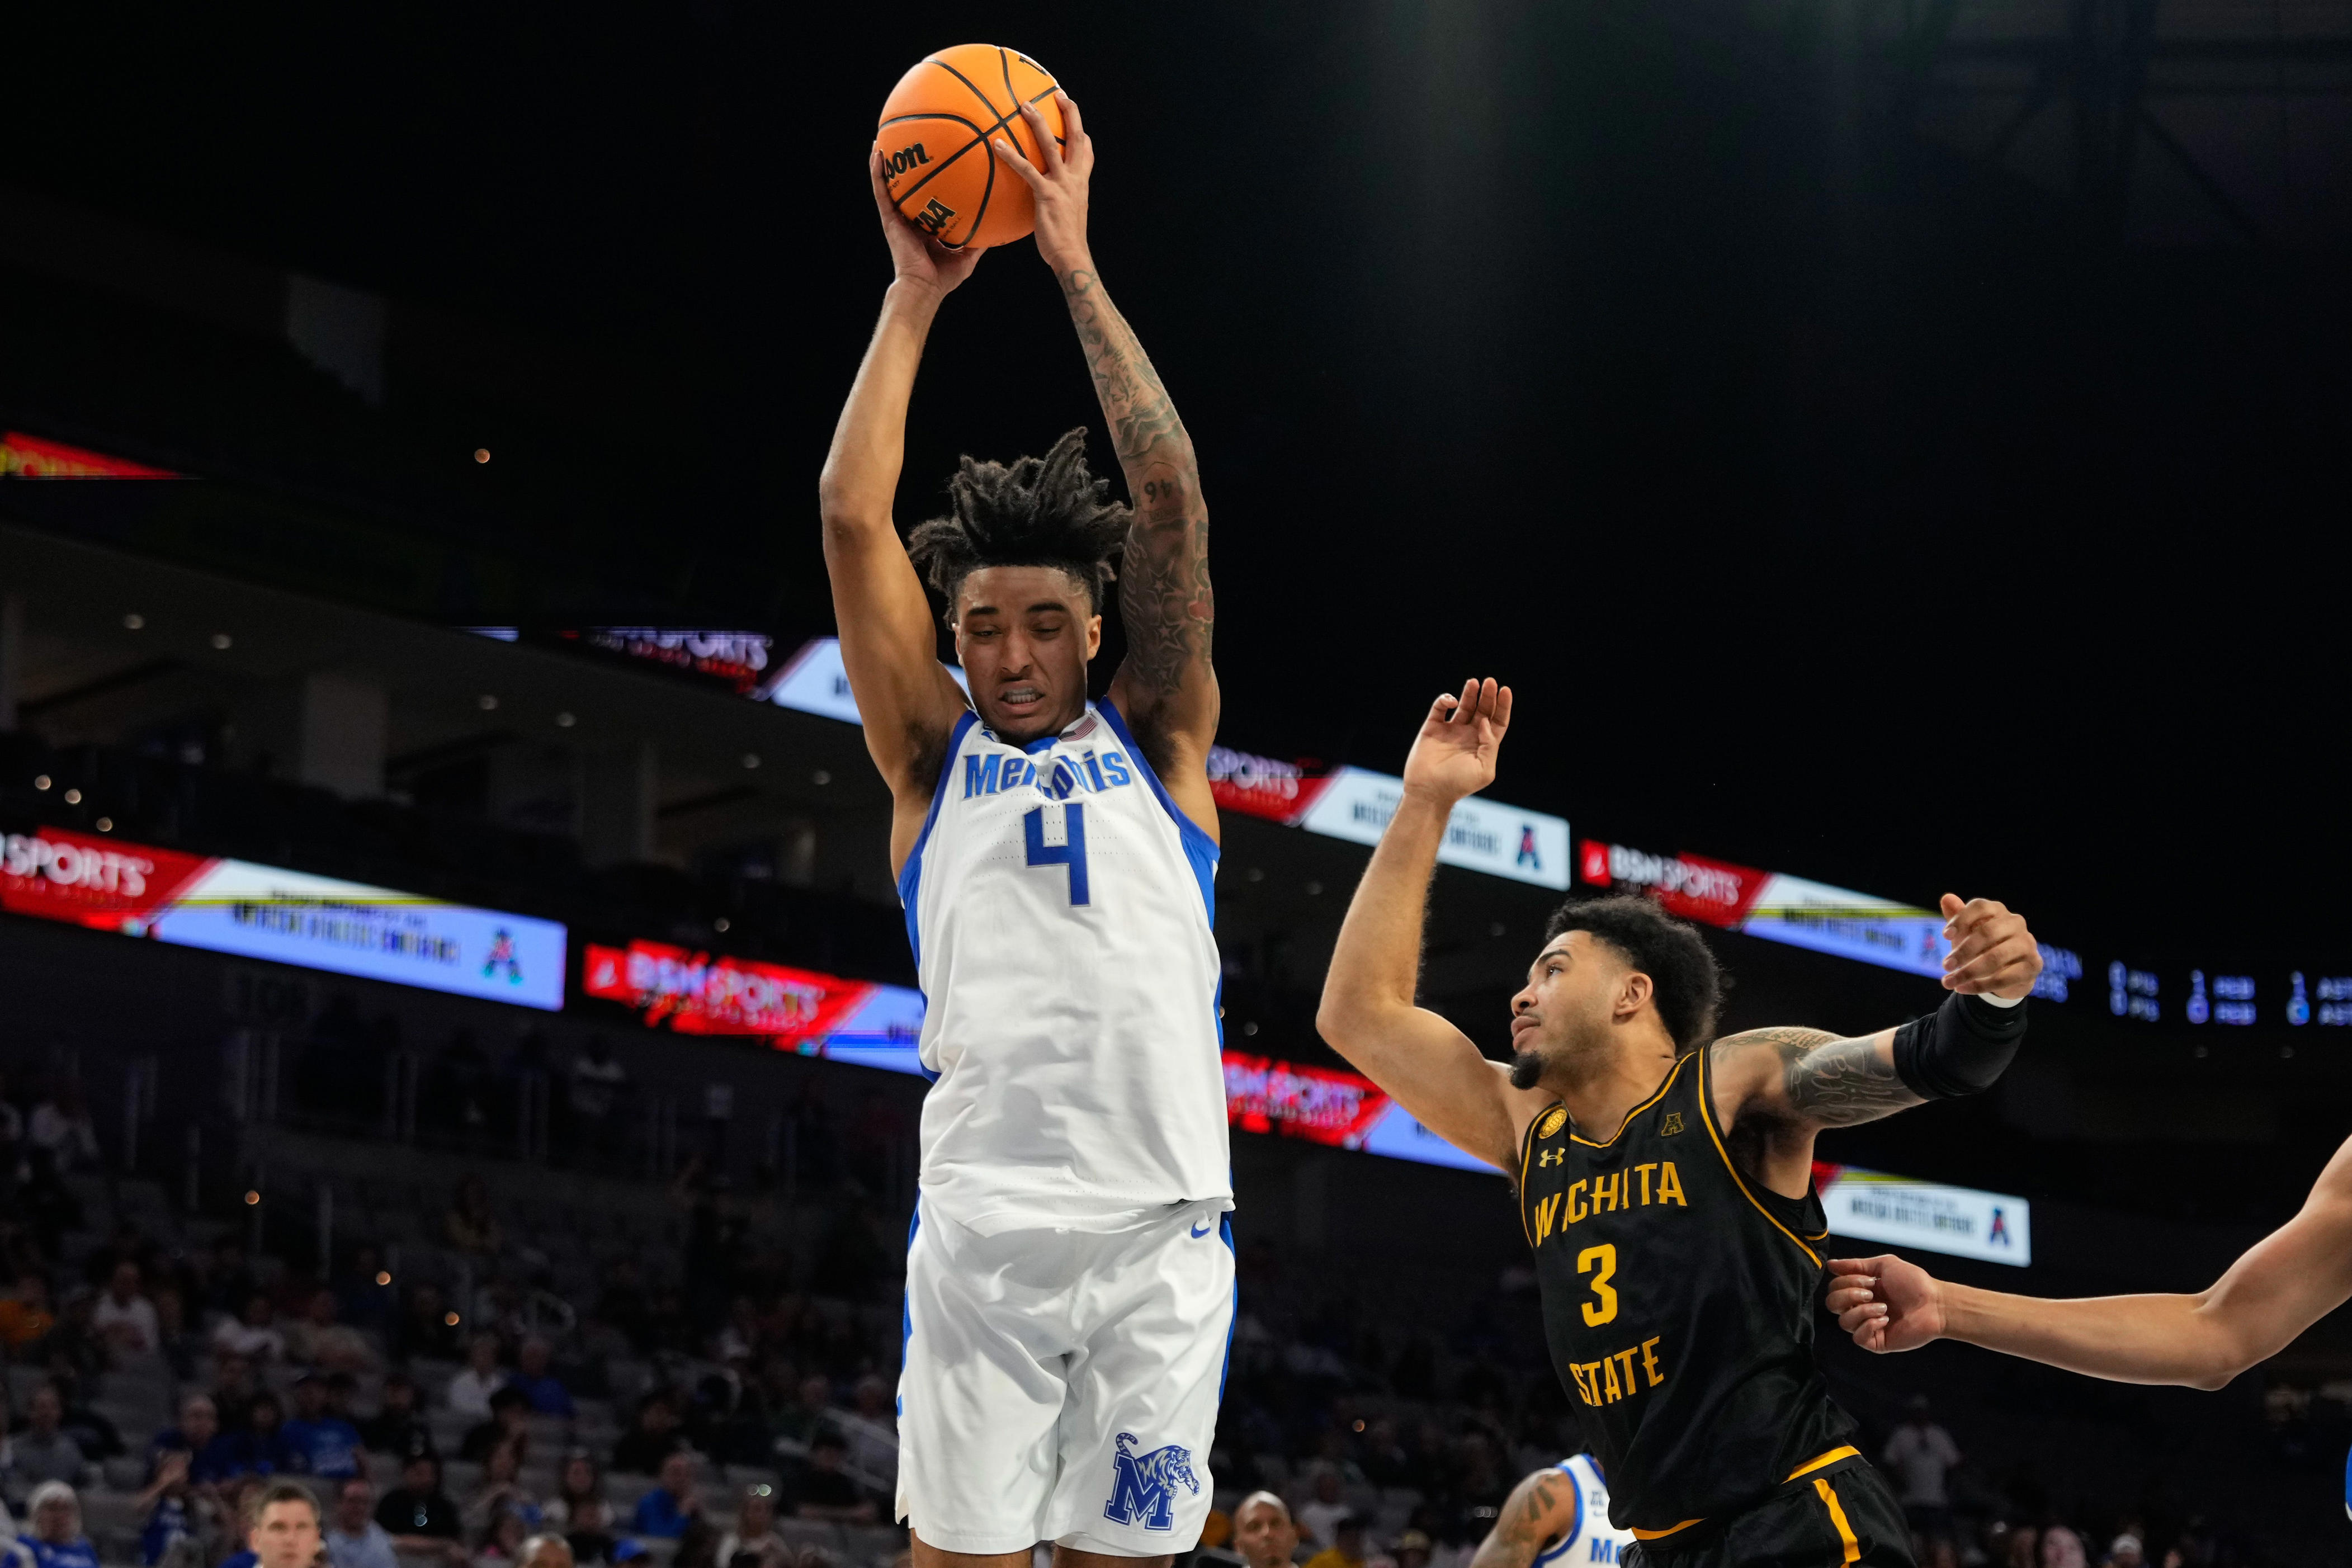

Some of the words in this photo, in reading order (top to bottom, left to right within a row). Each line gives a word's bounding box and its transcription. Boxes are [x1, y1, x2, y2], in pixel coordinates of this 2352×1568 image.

[1024, 802, 1090, 907] 4
[1535, 1161, 1688, 1248] WICHITA
[1578, 1243, 1617, 1328] 3
[1570, 1336, 1664, 1406] STATE
